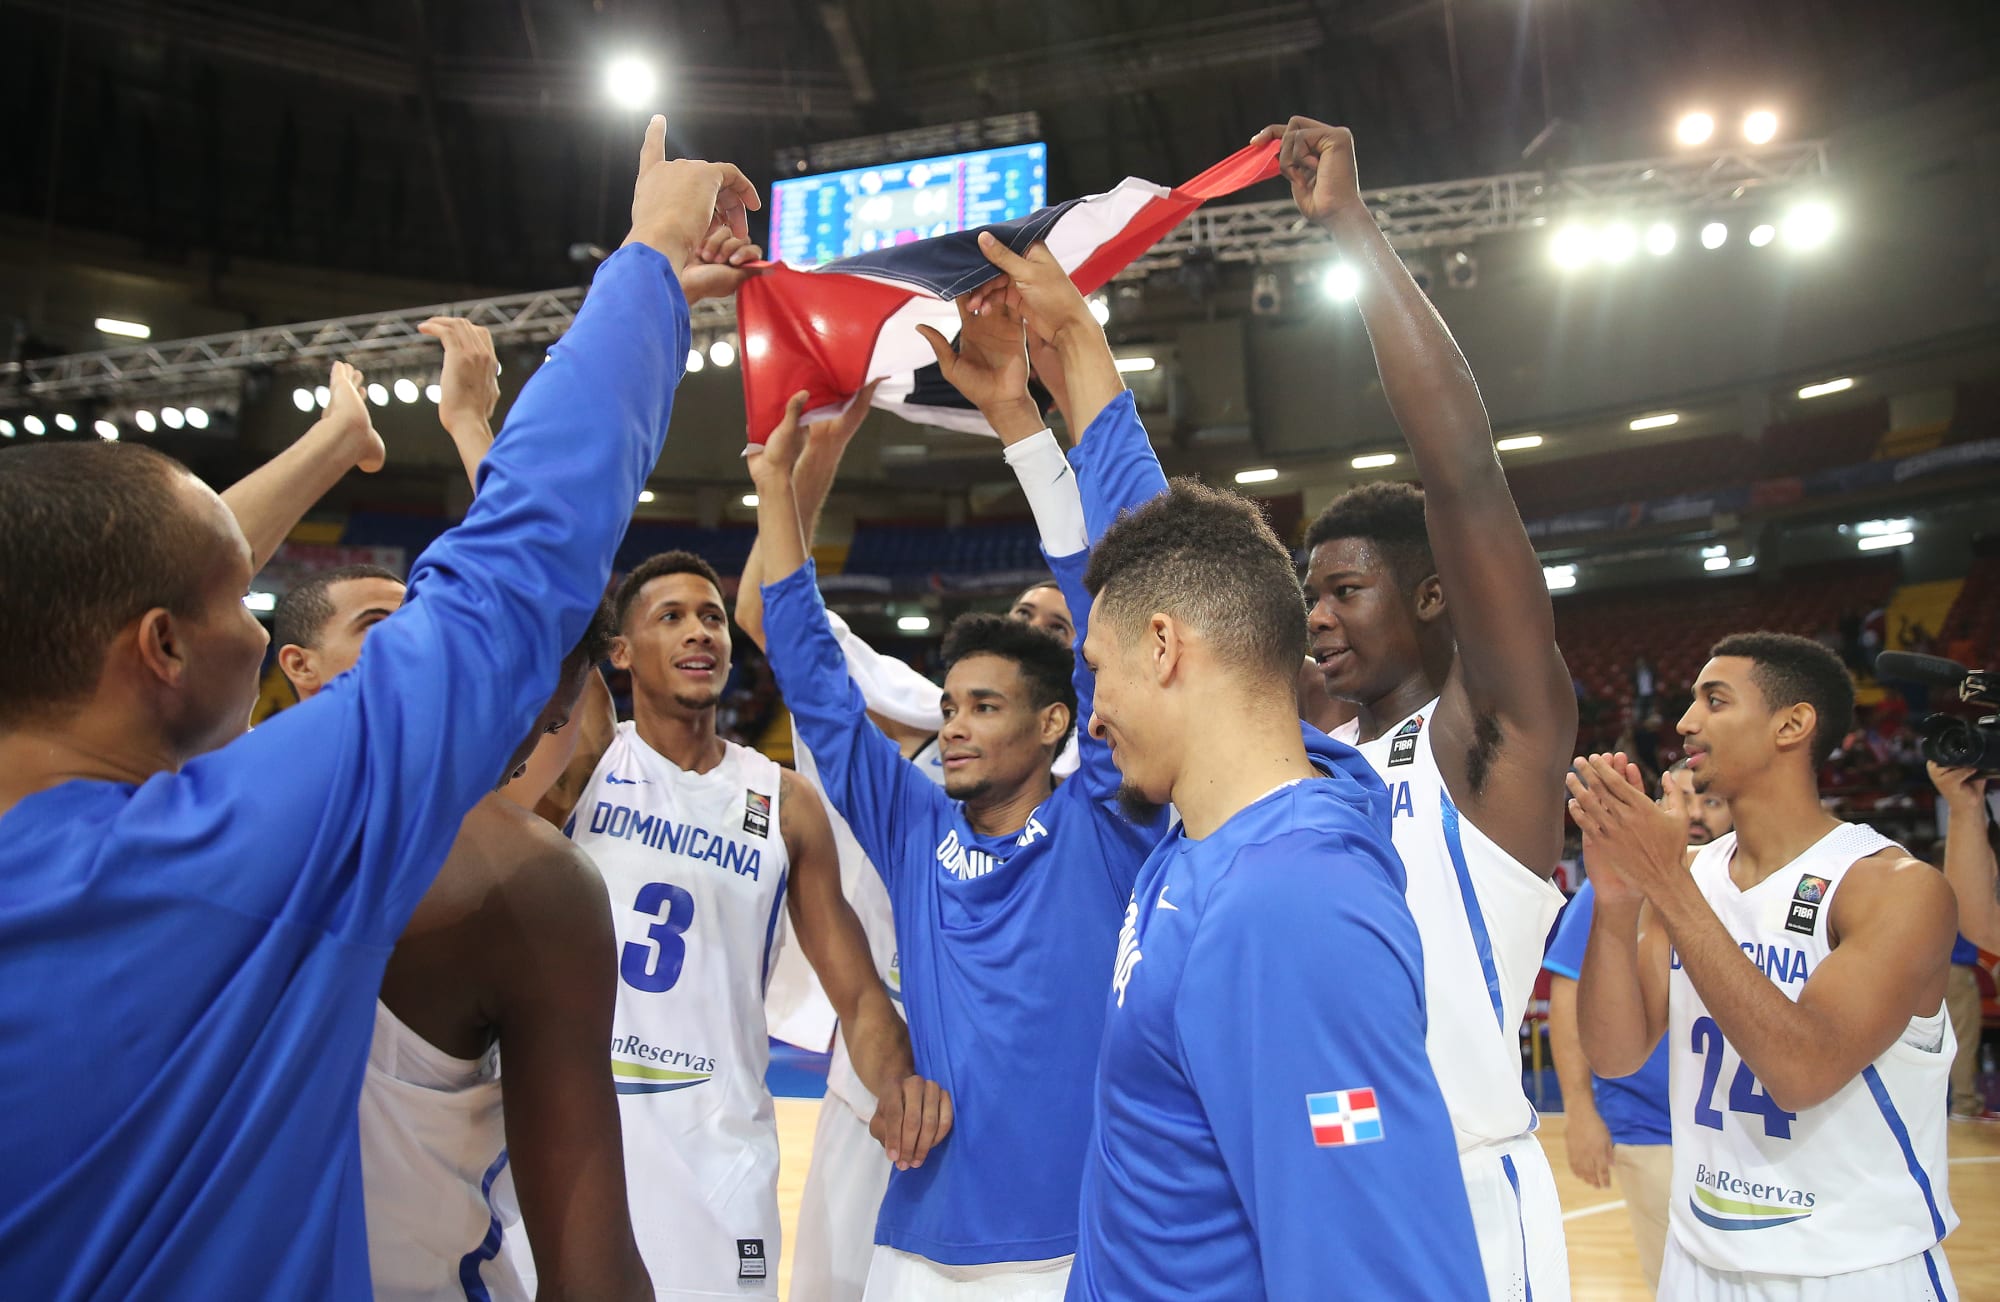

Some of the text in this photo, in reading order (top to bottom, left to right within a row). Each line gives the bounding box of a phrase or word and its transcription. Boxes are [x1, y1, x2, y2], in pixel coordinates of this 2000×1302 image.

[1394, 739, 1413, 751] FIBA
[590, 801, 761, 882] DOMINICANA
[1792, 905, 1813, 920] FIBA
[620, 882, 695, 994] 3
[611, 1035, 716, 1072] nReservas
[1691, 1016, 1797, 1140] 24
[1696, 1164, 1816, 1208] BanReservas
[744, 1244, 758, 1255] 50
